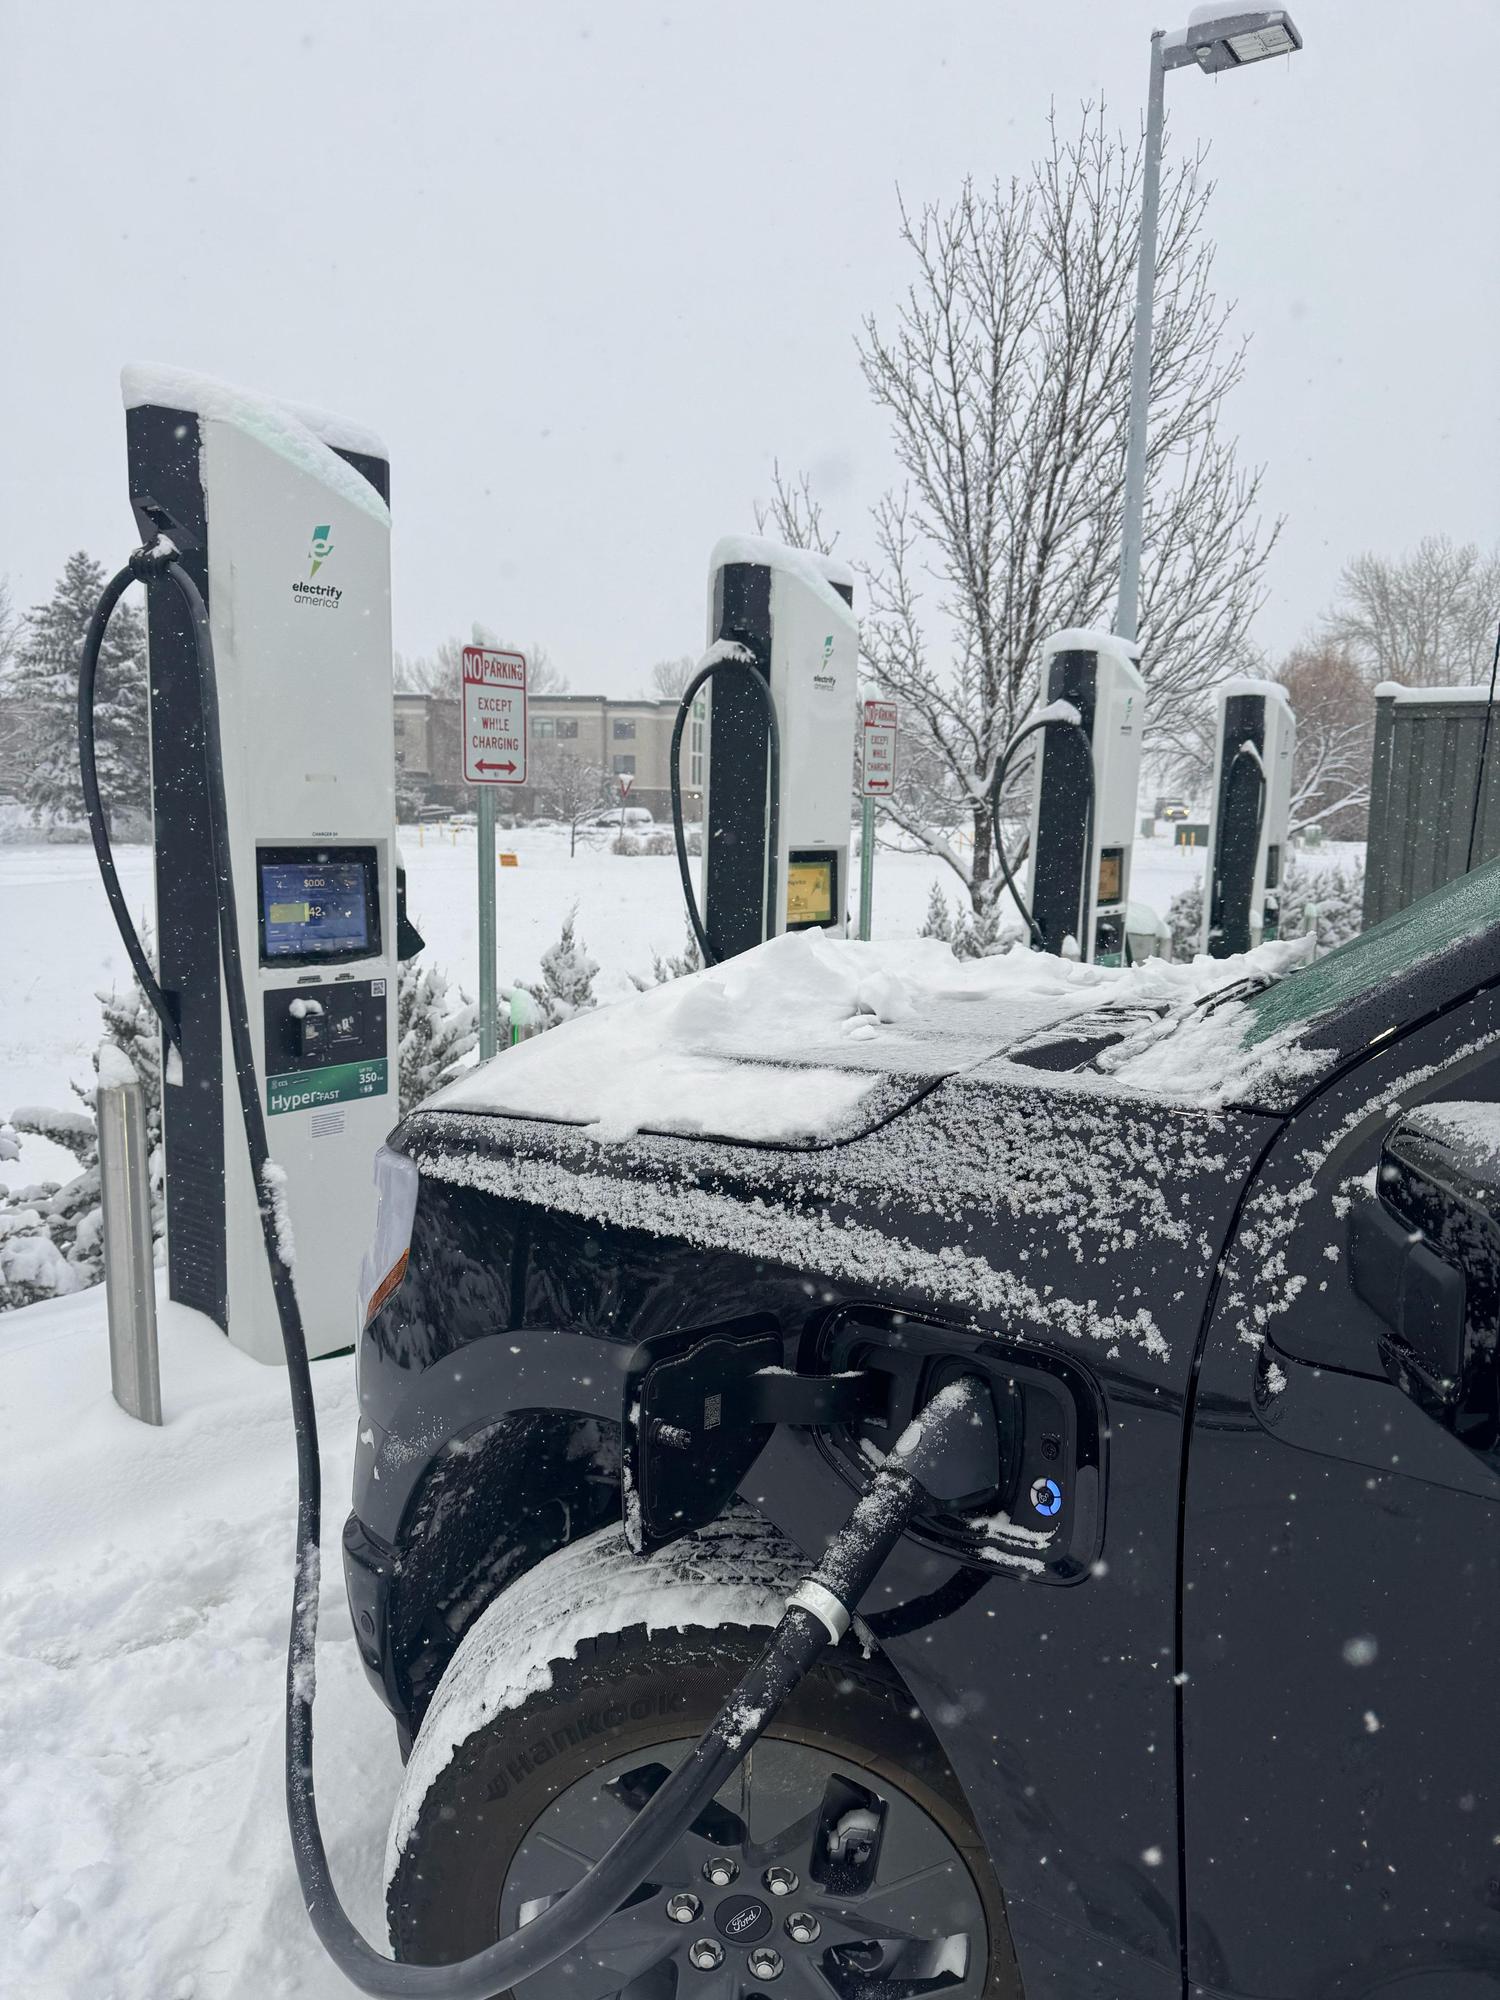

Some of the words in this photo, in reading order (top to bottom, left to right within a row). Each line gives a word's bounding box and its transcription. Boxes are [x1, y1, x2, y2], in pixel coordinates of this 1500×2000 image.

[292, 582, 342, 600] electrify
[294, 594, 339, 609] america
[464, 653, 482, 680] NO
[484, 659, 523, 681] PARKING
[478, 697, 512, 712] EXCEPT
[482, 717, 509, 731] WHILE
[472, 735, 519, 751] CHARGING
[303, 878, 325, 888] $0.00
[359, 1072, 377, 1084] 350
[731, 1910, 757, 1931] Ford
